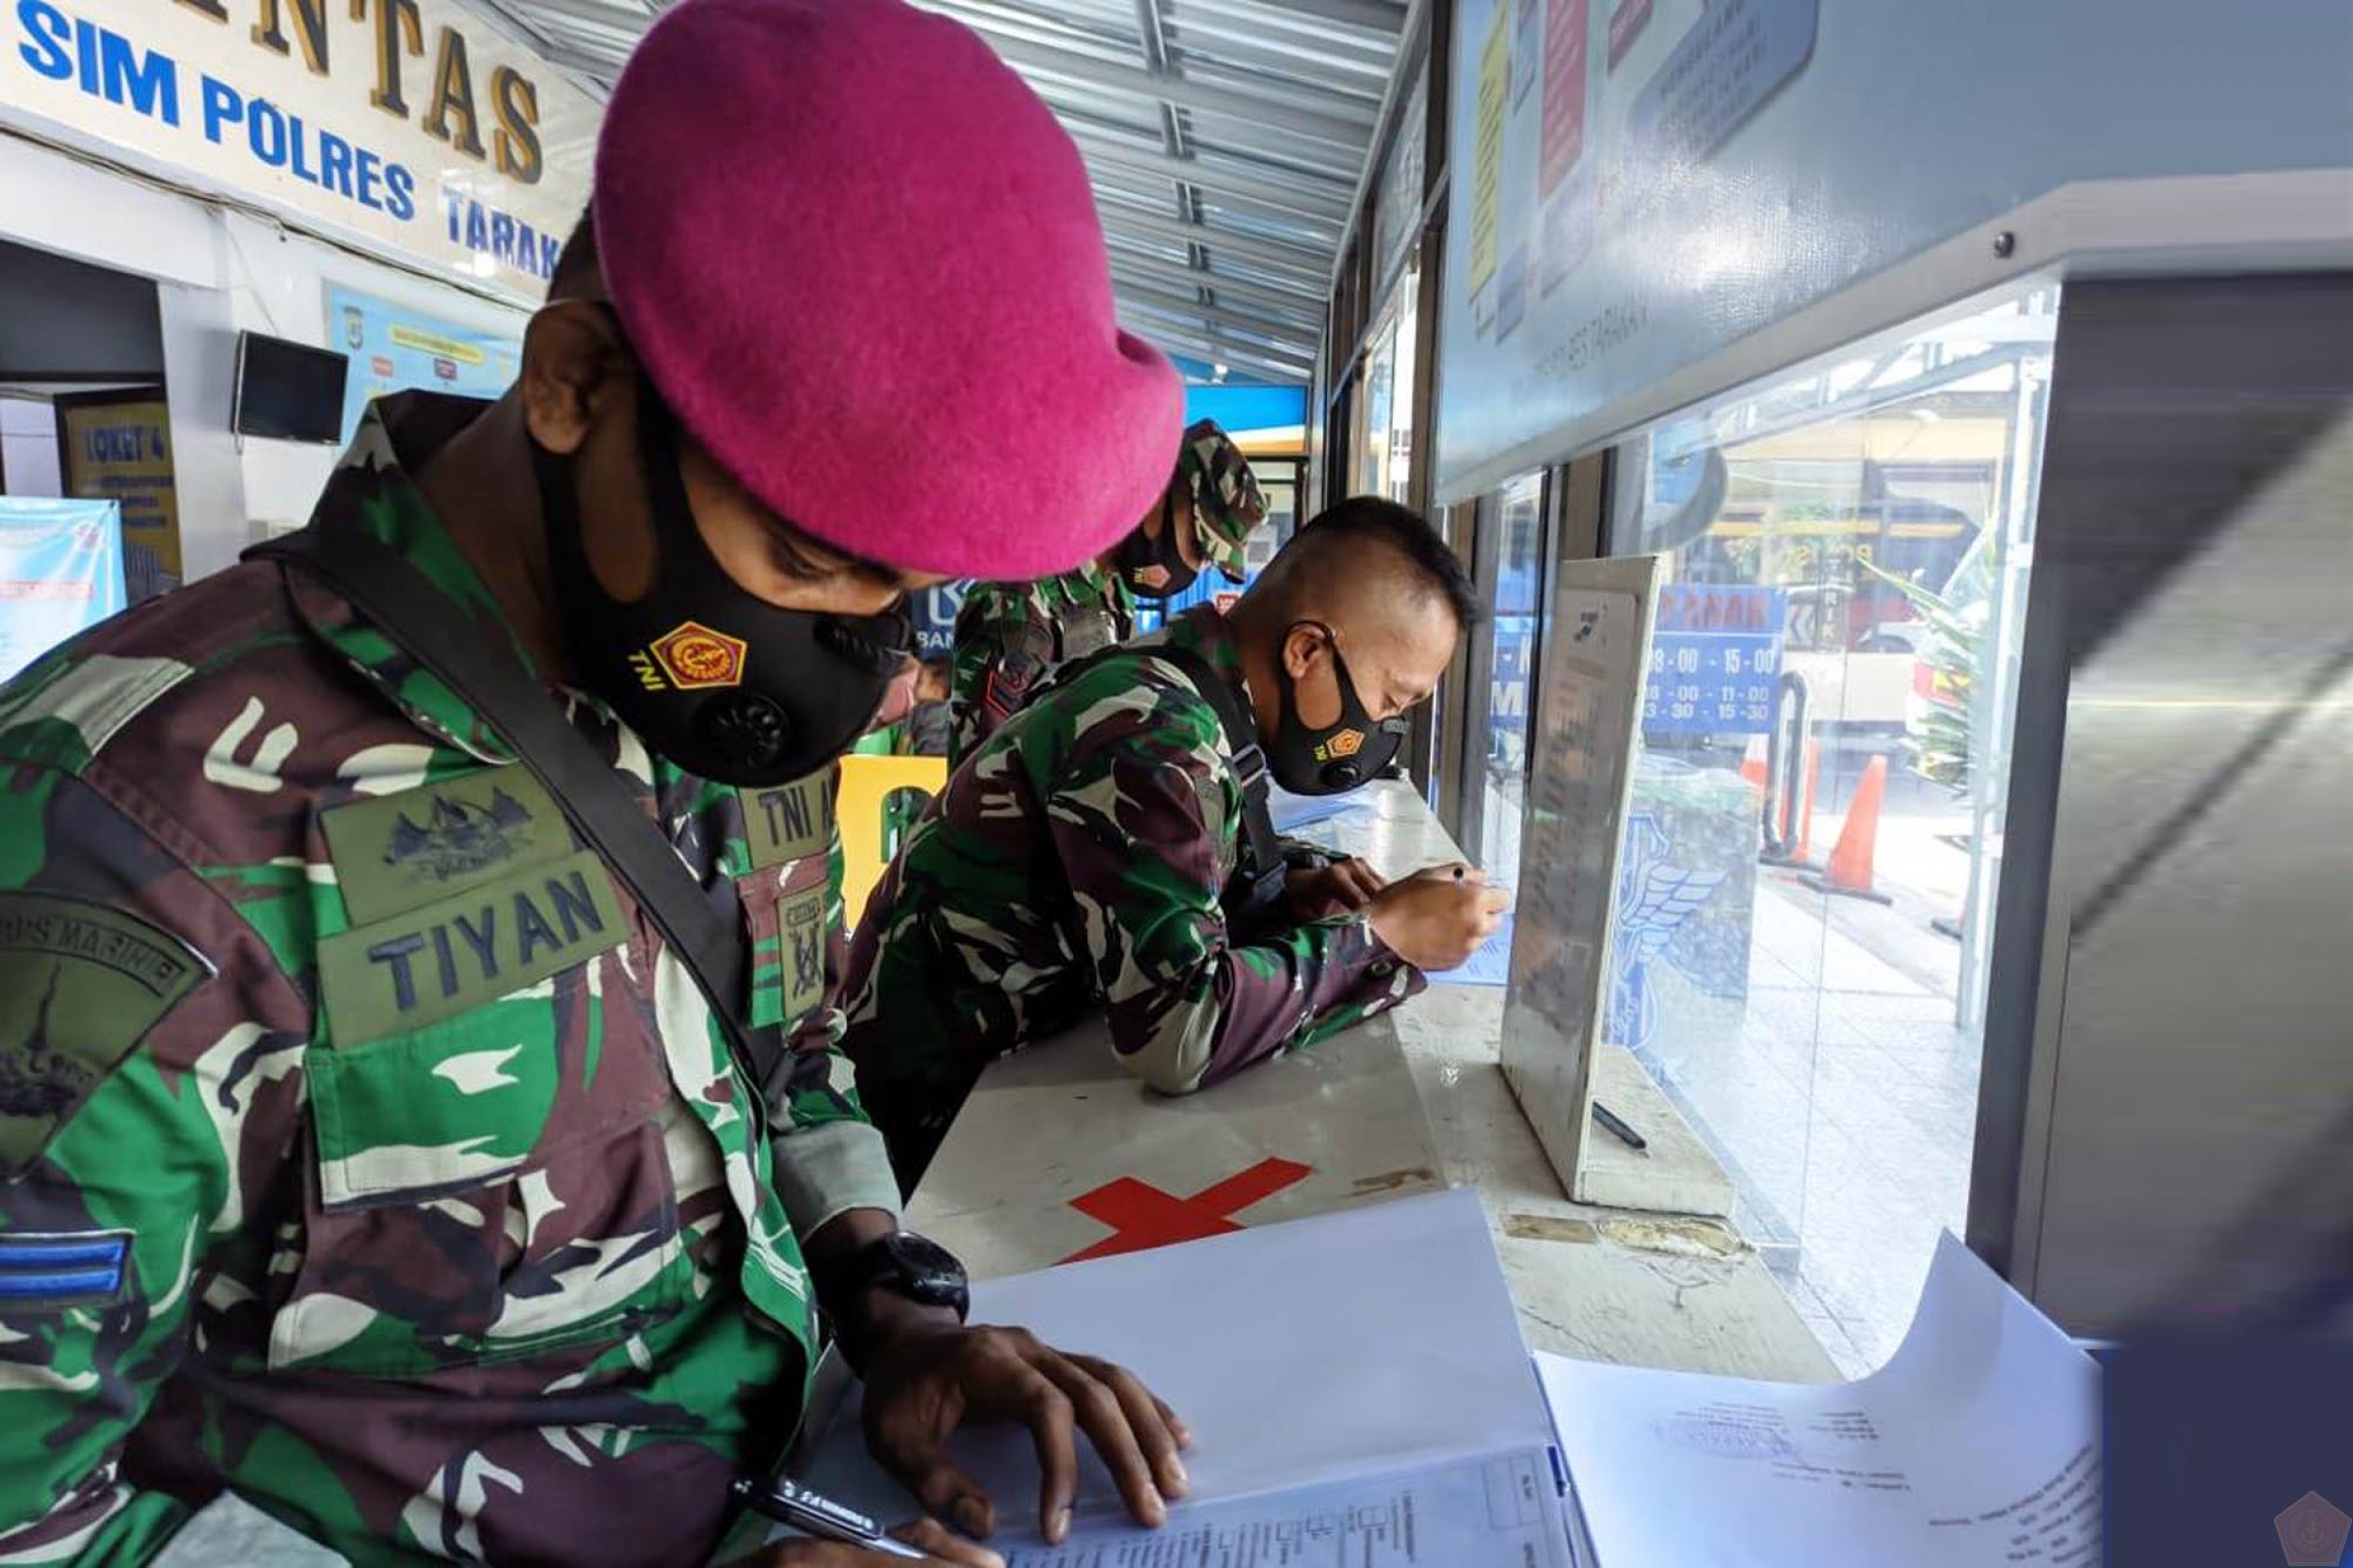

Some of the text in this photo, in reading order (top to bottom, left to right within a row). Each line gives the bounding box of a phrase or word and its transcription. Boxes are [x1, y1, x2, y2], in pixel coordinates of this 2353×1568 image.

[16, 0, 180, 128] SIM
[200, 73, 415, 222] POLRES
[172, 0, 543, 184] NTAS
[628, 649, 666, 691] TNI
[758, 785, 814, 846] TNI
[366, 870, 605, 1012] TIYAN
